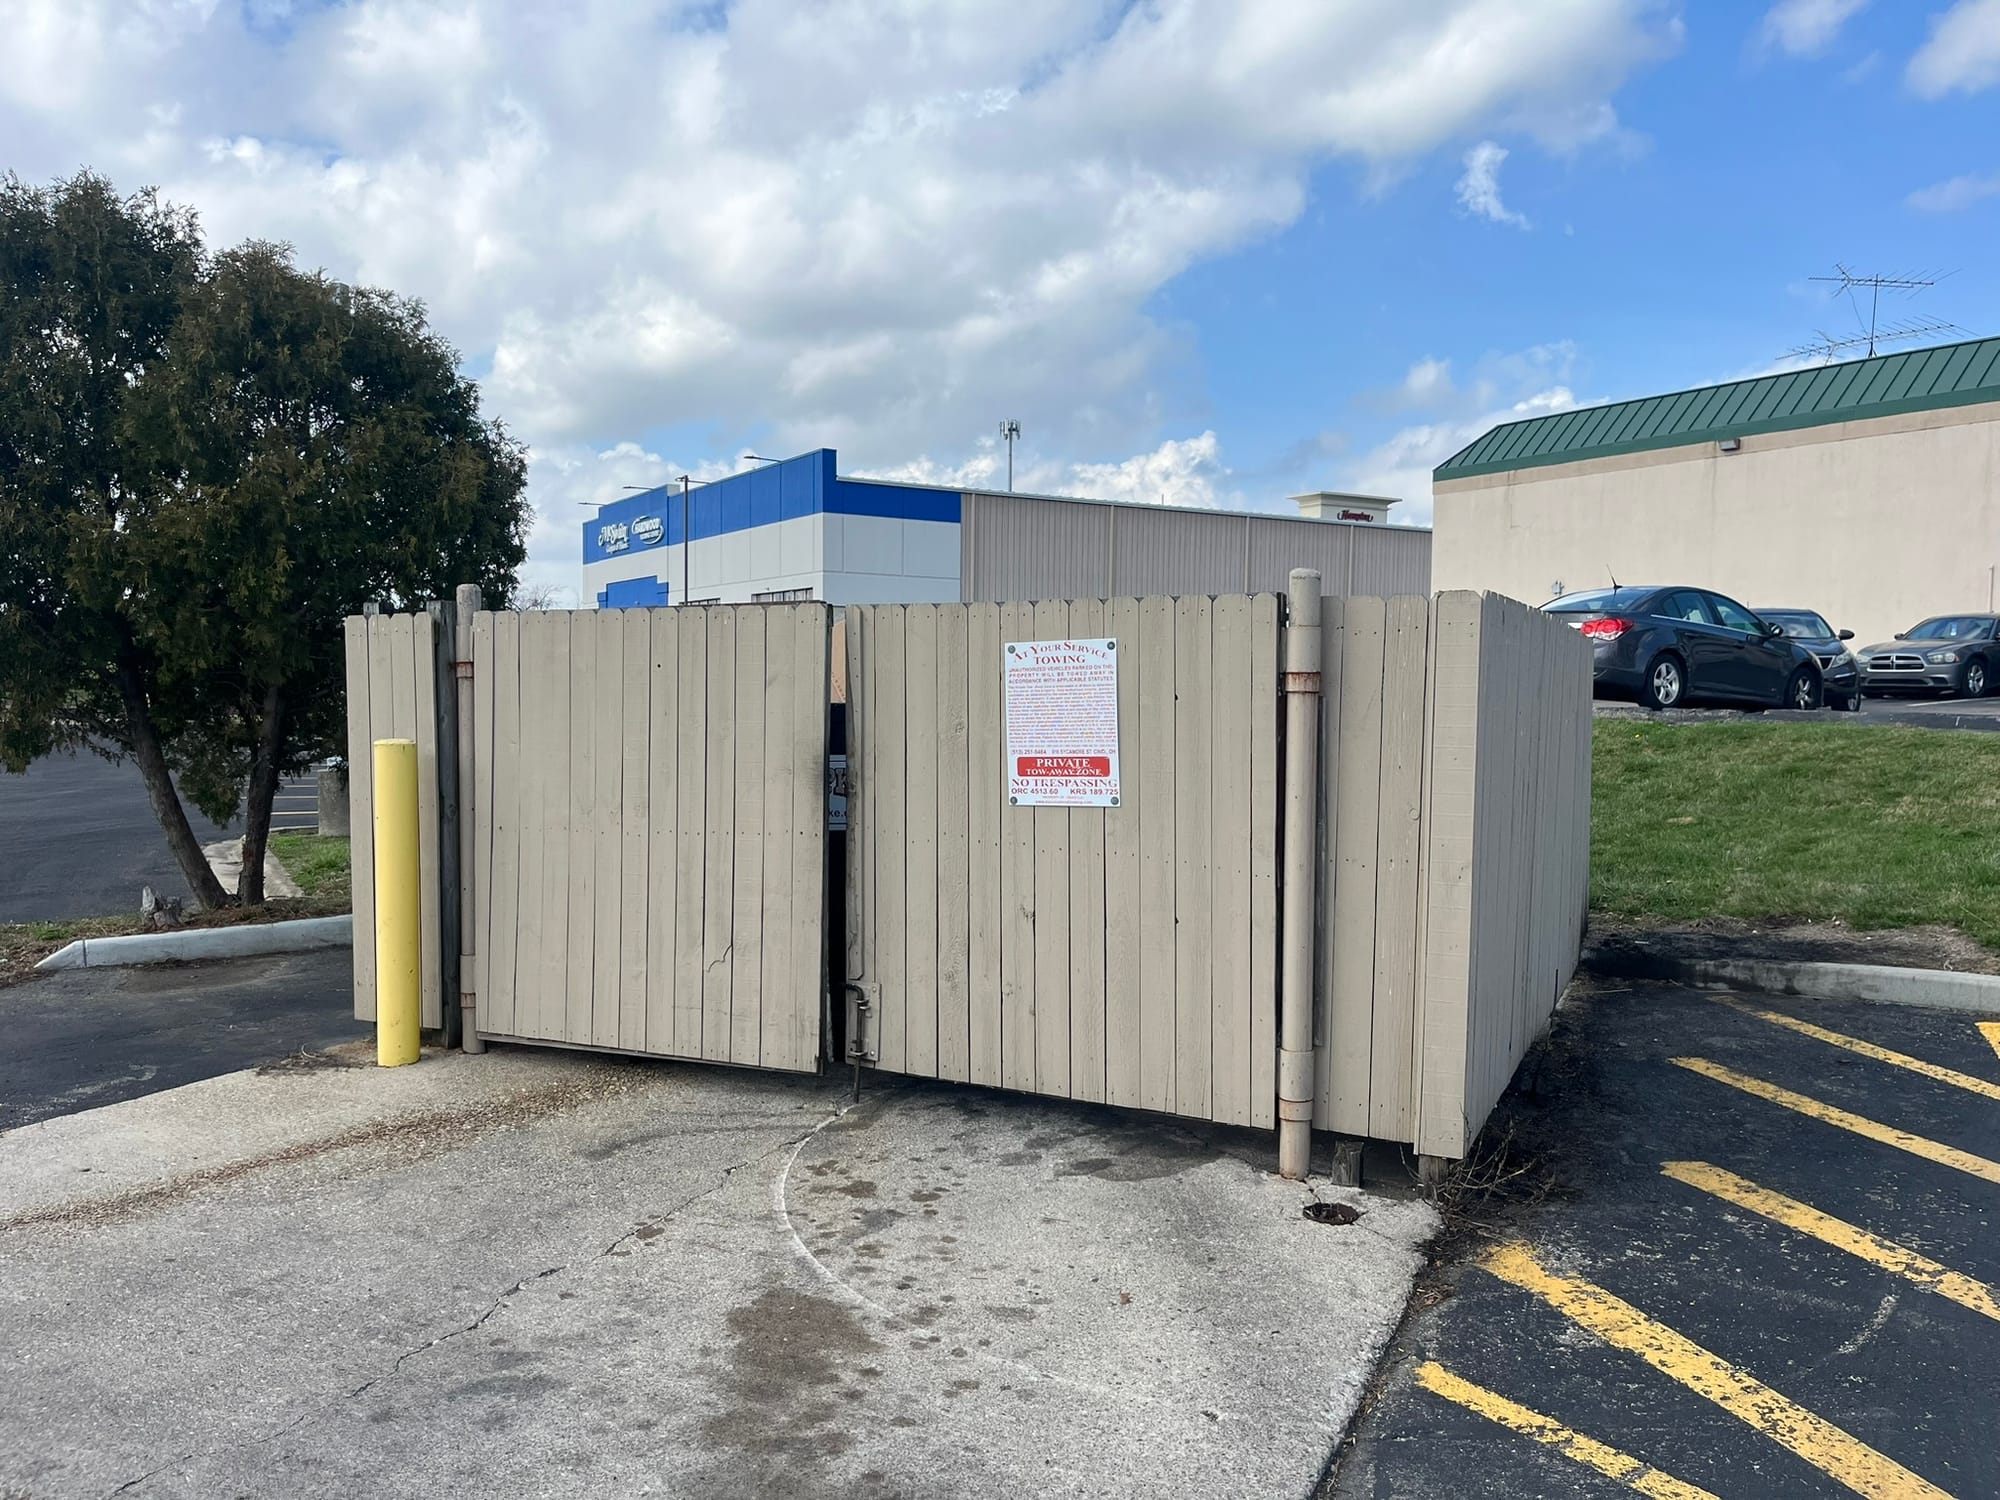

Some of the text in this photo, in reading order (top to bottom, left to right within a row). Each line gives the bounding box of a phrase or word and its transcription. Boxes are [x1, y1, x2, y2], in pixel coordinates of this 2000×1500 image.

[1034, 655, 1086, 665] TOWING
[1036, 758, 1090, 768] PRIVATE
[1011, 779, 1118, 788] NO TRESPASSING
[1089, 788, 1119, 796] 189.725
